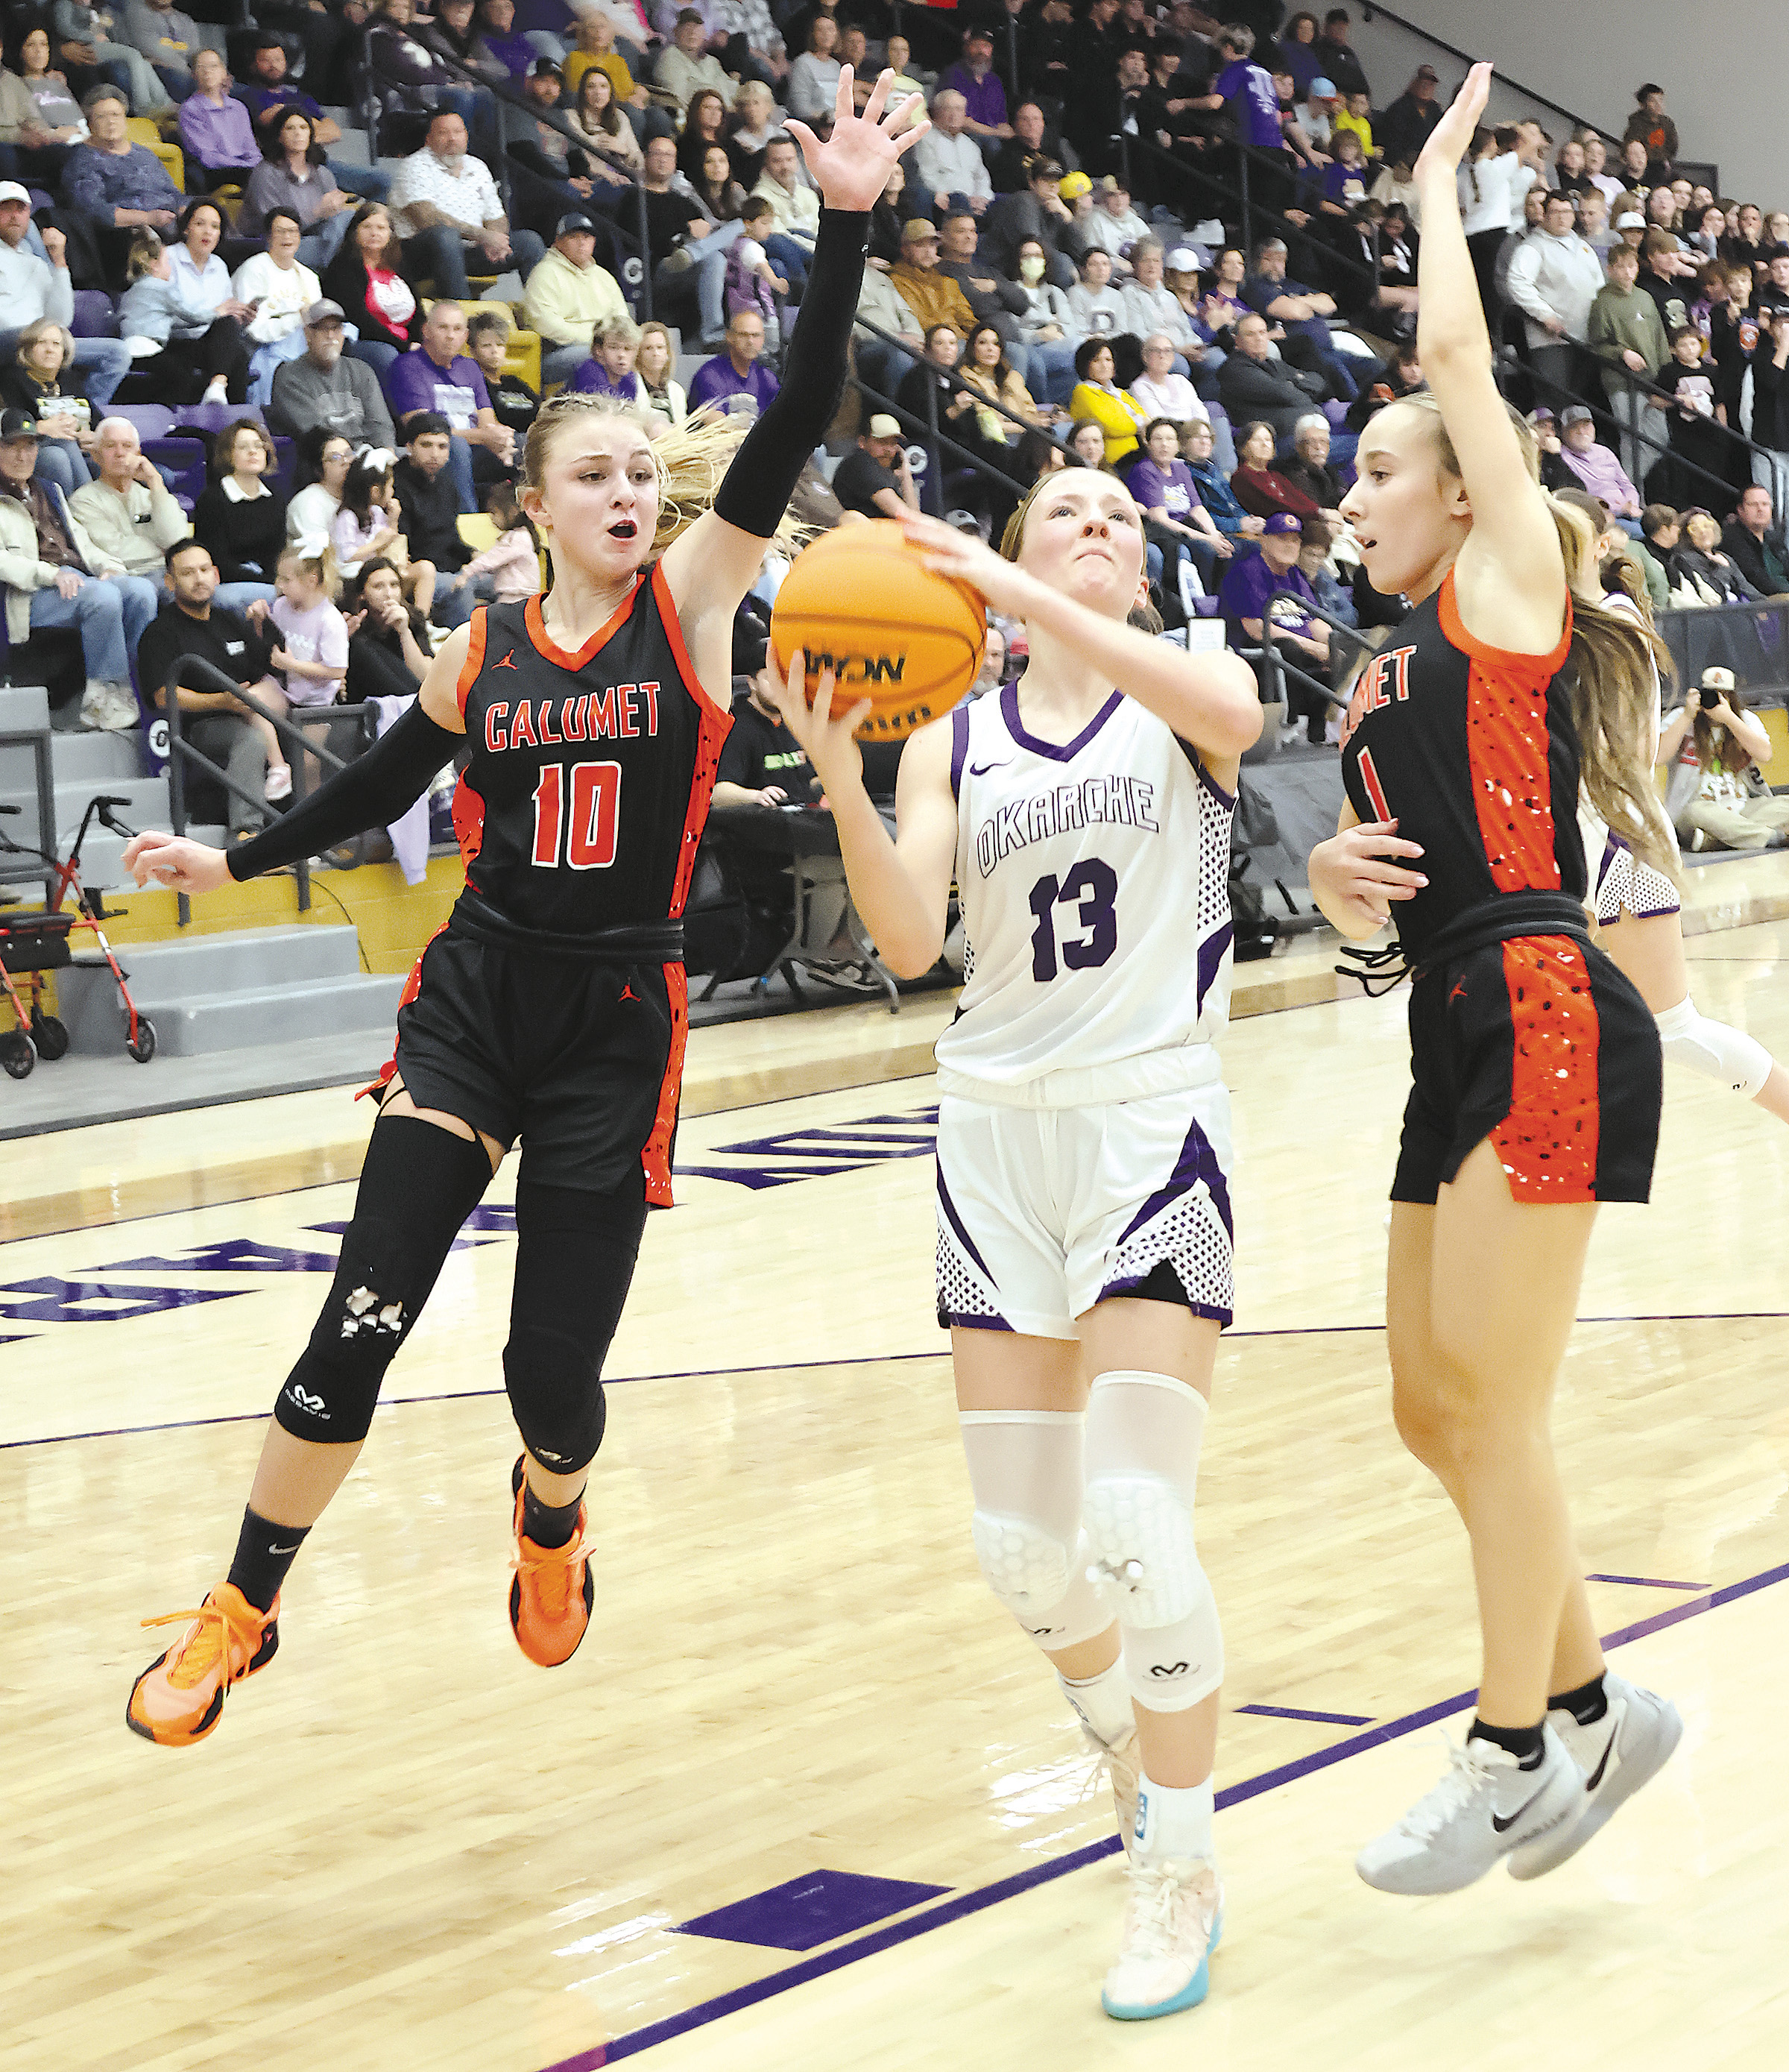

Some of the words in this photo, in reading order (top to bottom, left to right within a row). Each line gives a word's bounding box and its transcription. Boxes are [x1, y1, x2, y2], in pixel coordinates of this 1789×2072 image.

[485, 681, 661, 753] CALUMET
[531, 760, 622, 871] 10
[976, 774, 1160, 879] OKARCHE
[1028, 857, 1118, 982] 13
